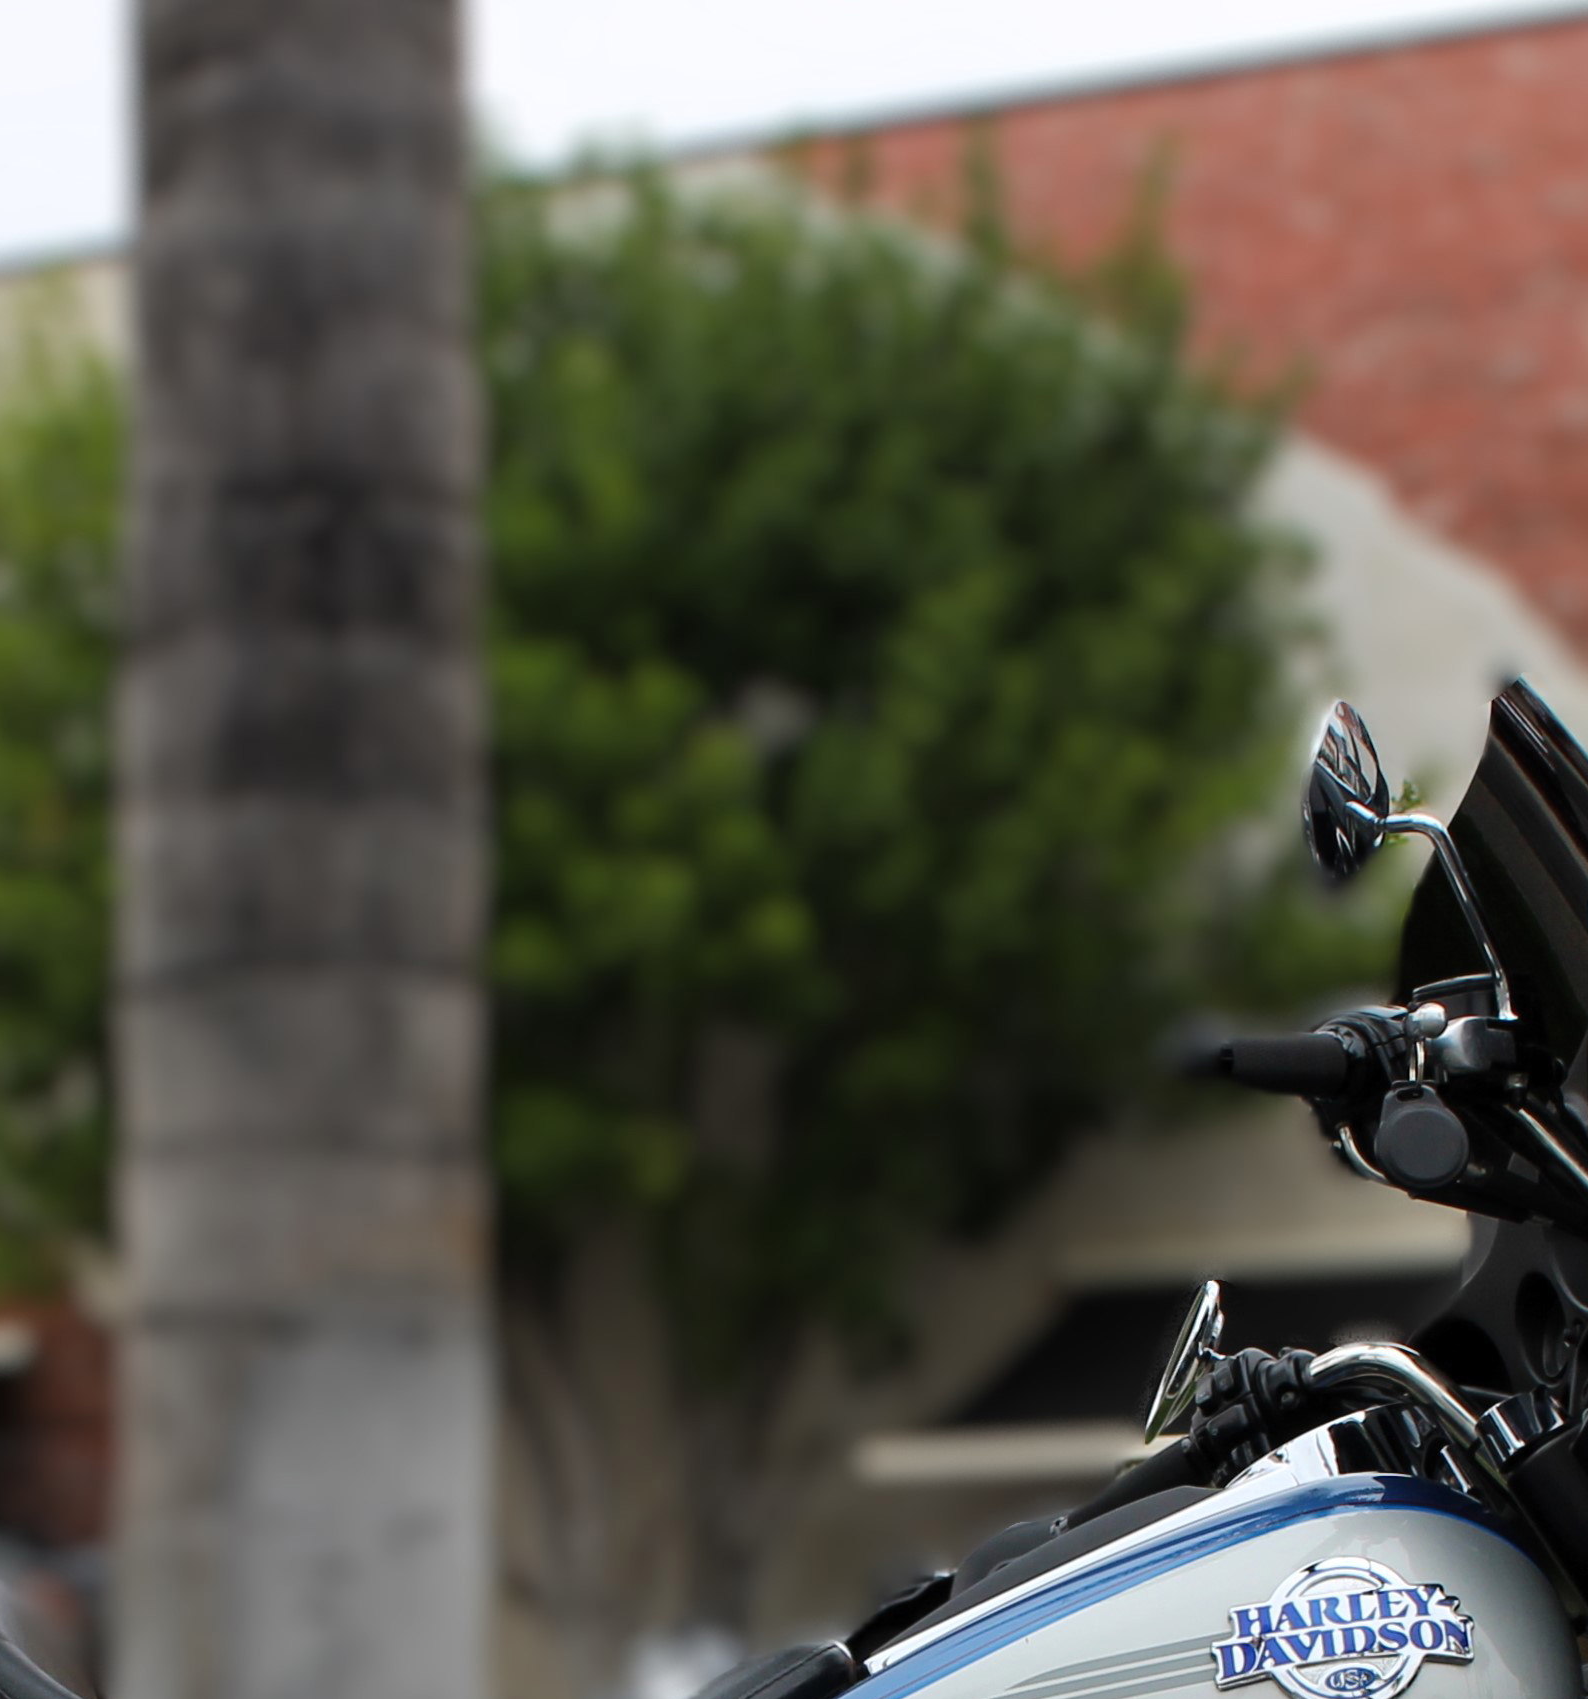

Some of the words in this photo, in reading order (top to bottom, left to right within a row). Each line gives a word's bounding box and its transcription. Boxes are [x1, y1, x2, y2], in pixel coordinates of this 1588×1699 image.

[1234, 1585, 1460, 1638] HARLEY-
[1216, 1617, 1470, 1680] DAVIDSON
[1328, 1667, 1372, 1690] USA
